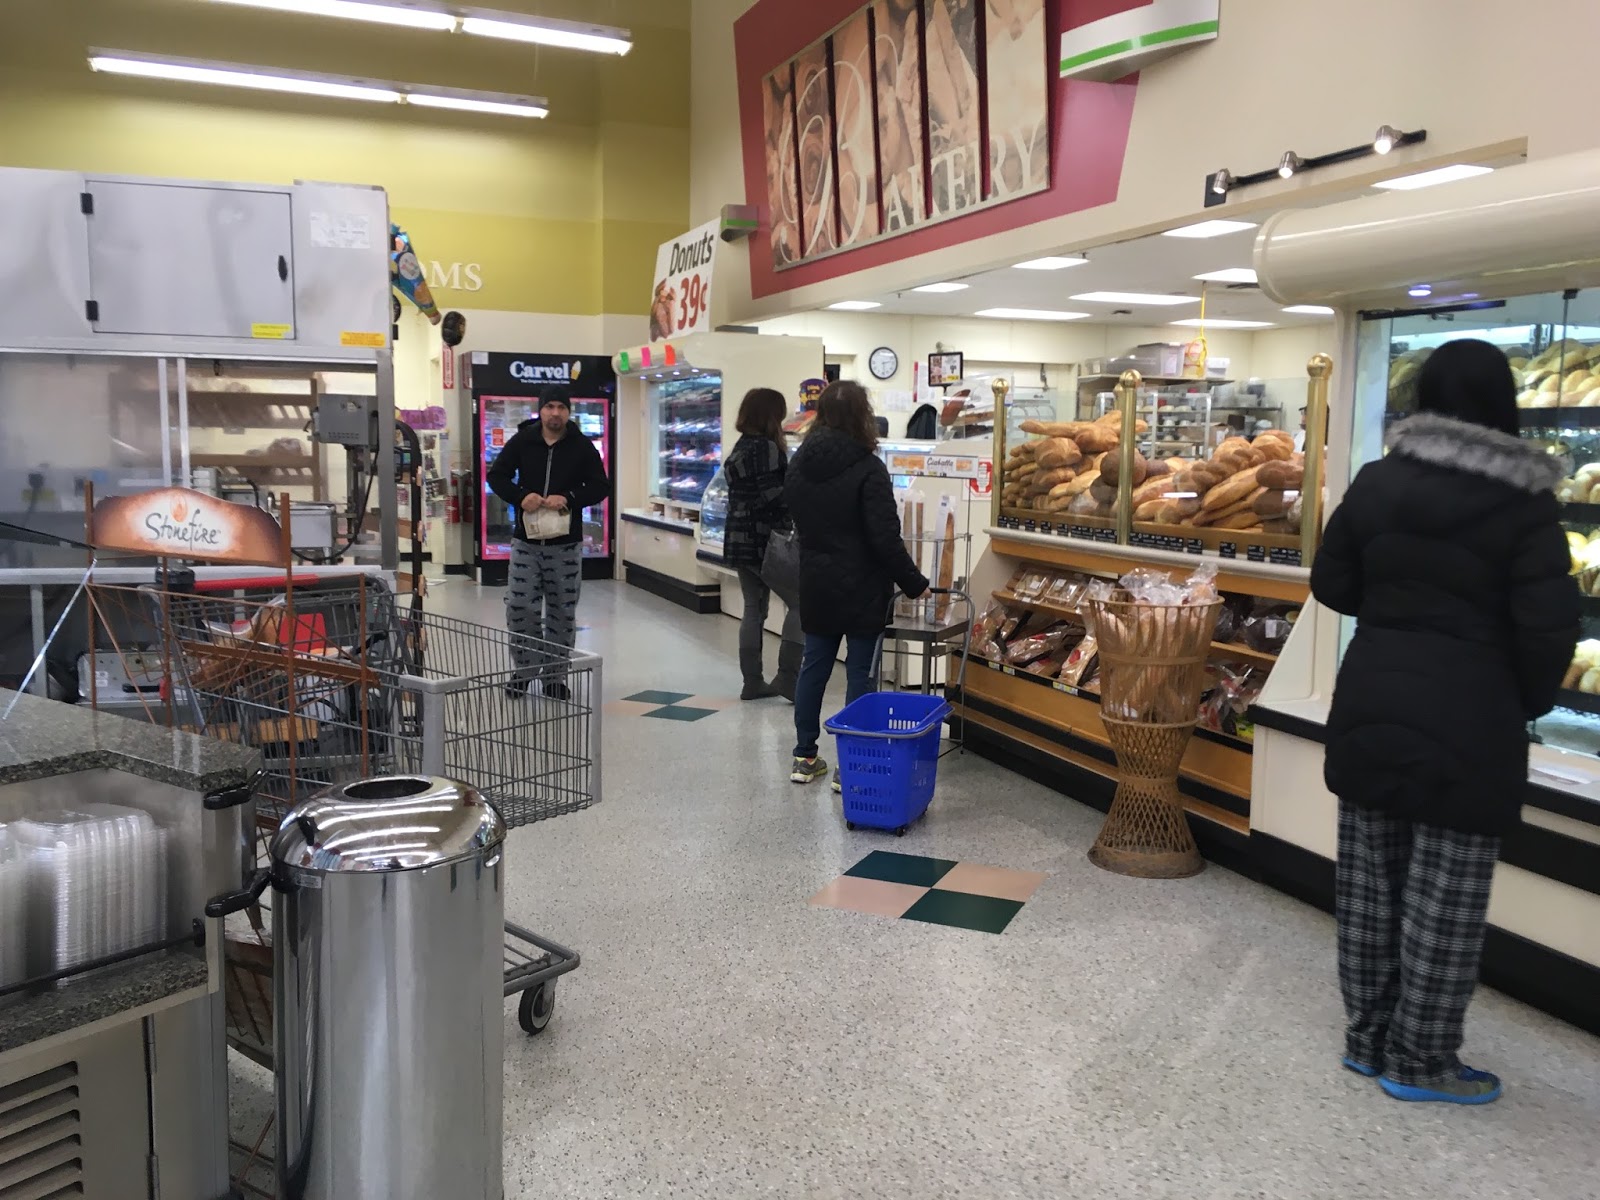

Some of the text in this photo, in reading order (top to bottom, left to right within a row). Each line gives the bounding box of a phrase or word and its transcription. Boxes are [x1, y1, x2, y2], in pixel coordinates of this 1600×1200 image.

[780, 34, 1045, 263] BAKERY
[669, 231, 714, 277] Donuts
[677, 273, 708, 330] 39¢
[509, 360, 570, 380] Carvel
[145, 508, 219, 551] Stonefire
